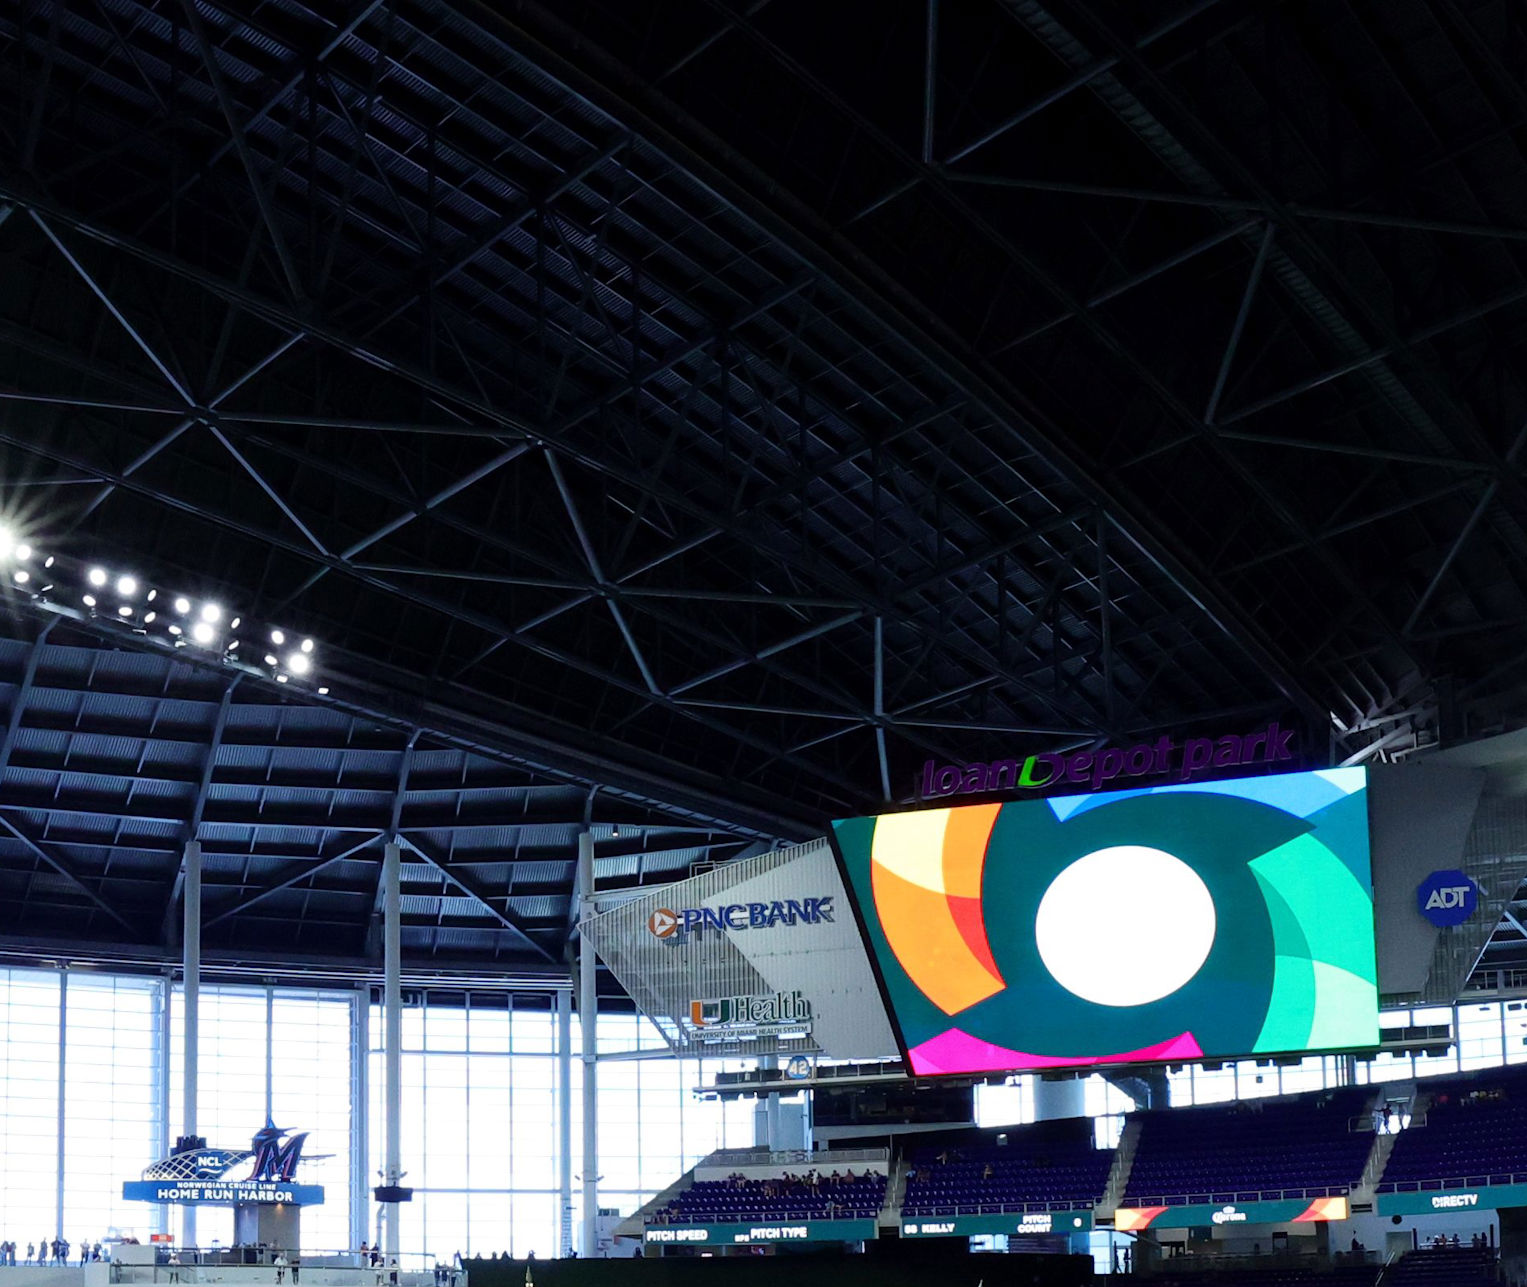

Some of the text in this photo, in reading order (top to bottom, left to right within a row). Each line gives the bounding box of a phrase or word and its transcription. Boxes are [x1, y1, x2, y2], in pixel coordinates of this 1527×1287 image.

[921, 721, 1295, 799] loanDepot park
[1425, 886, 1470, 910] ADT
[691, 1030, 726, 1040] UNIVERSITY
[759, 1027, 782, 1035] HEALTH
[783, 1025, 808, 1034] SYSTEM
[789, 1062, 808, 1076] 42
[197, 1156, 223, 1167] NCL
[176, 1181, 277, 1191] NORWEGIAN CRUISE LINE
[157, 1189, 293, 1202] HOME RUN HARBOR
[1431, 1194, 1478, 1208] DIRECTV
[1023, 1214, 1052, 1224] PITCH
[1211, 1210, 1247, 1224] Corona
[646, 1230, 674, 1242] PITCH
[676, 1229, 708, 1241] SPEED
[750, 1227, 780, 1239] PITCH
[781, 1226, 808, 1238] TYPE
[921, 1223, 956, 1234] KELLY
[1017, 1223, 1052, 1234] COUNT
